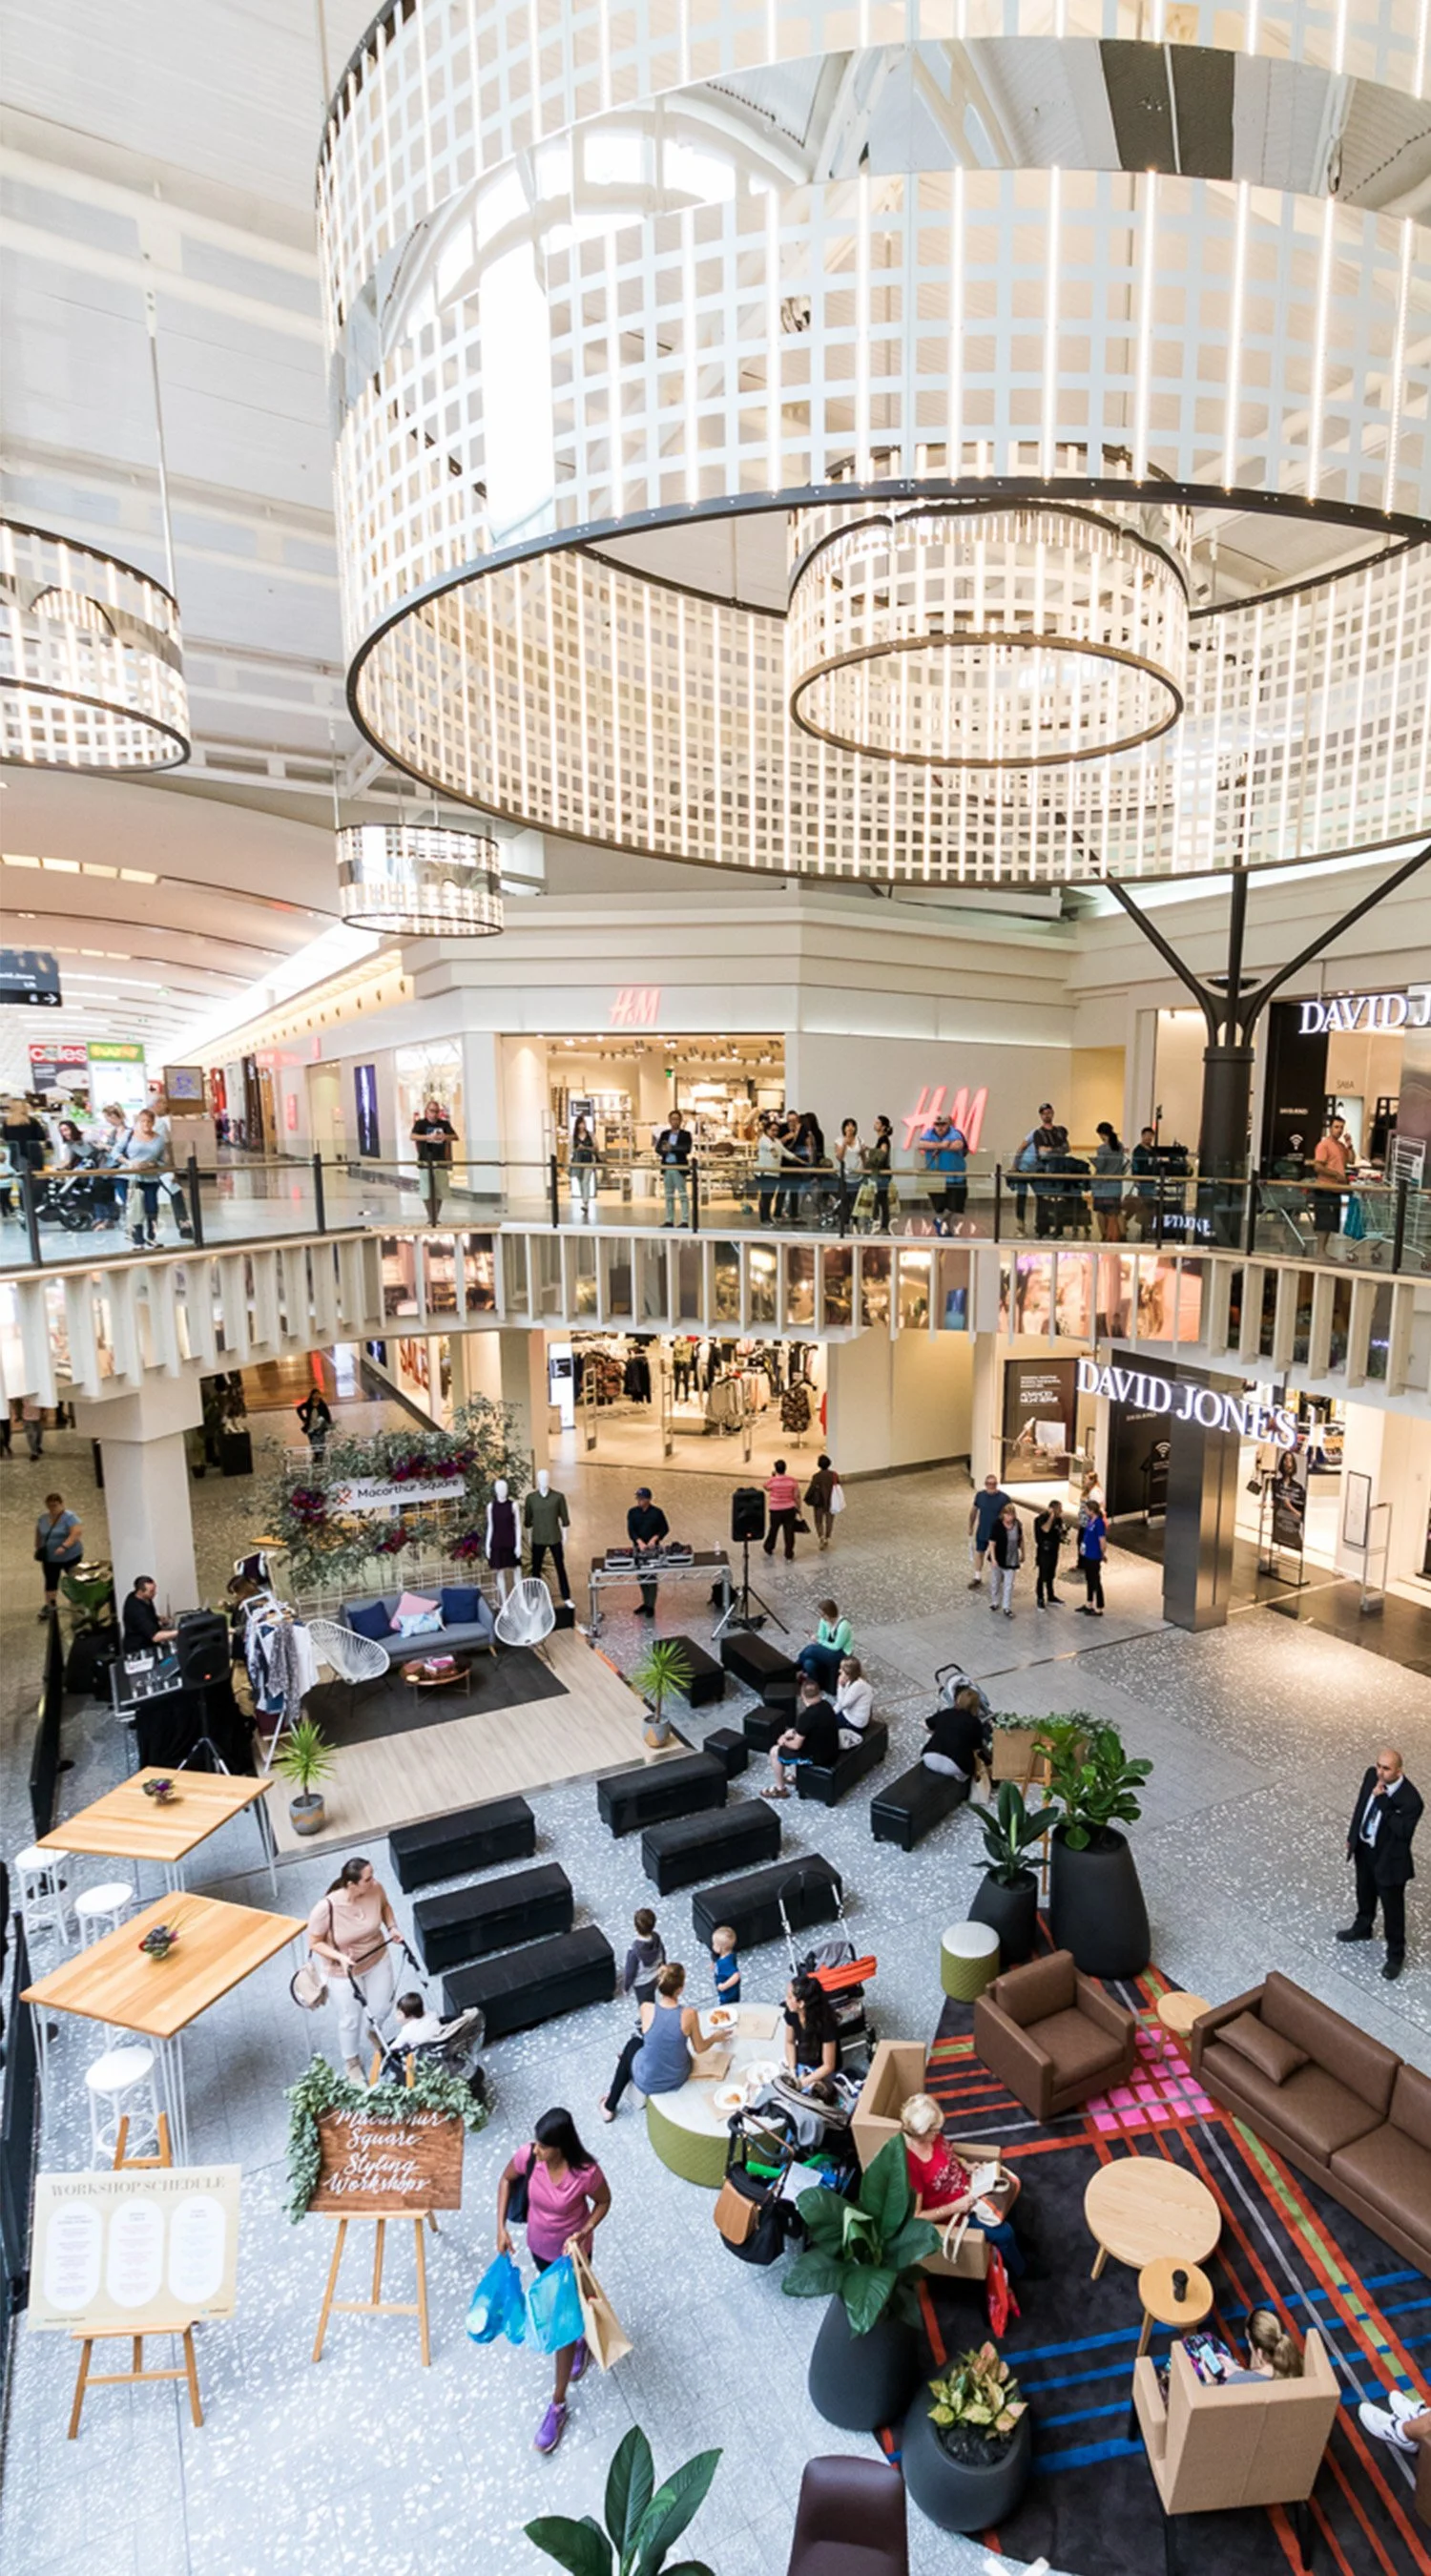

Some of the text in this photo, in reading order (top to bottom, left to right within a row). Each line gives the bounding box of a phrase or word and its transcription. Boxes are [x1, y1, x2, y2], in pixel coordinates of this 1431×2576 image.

[609, 988, 660, 1027] H&M
[1297, 994, 1409, 1034] DAVID
[902, 1085, 989, 1155] HM
[1076, 1358, 1297, 1452] DAVID JONES
[357, 1478, 459, 1499] Macarthur Square
[346, 2127, 423, 2152] Square
[343, 2151, 421, 2178] Styling
[52, 2175, 225, 2197] WORKSHOP SCHEDULE
[322, 2171, 431, 2195] Workshops
